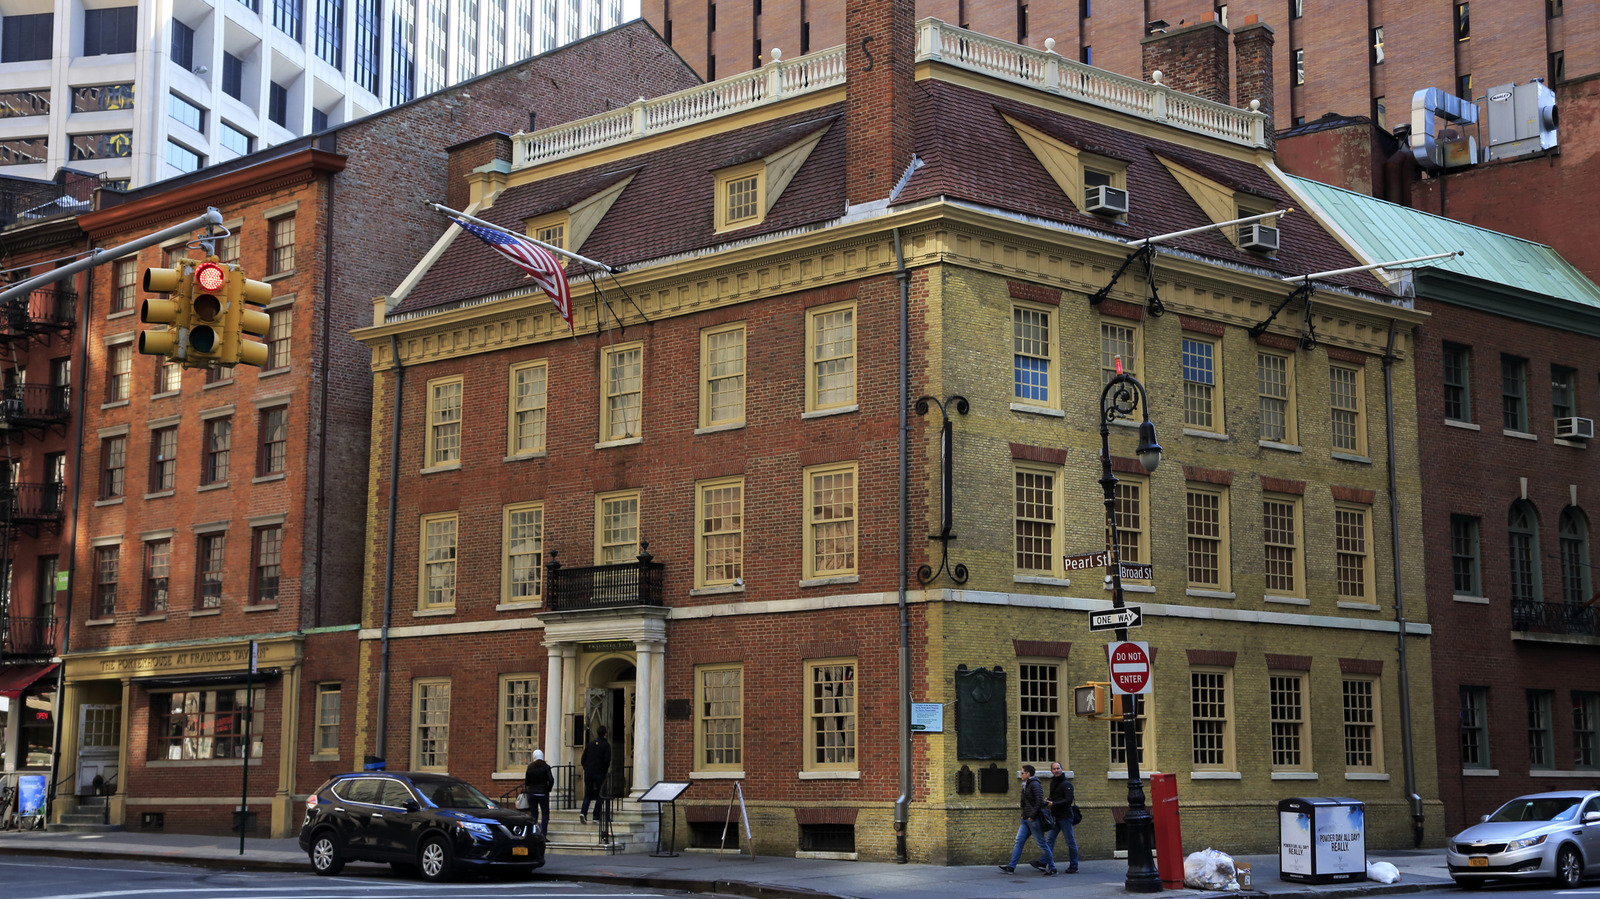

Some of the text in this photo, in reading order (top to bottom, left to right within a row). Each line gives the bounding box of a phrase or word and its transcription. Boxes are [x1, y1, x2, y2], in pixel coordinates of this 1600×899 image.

[1065, 555, 1094, 571] Pearl
[1096, 554, 1107, 567] St
[1121, 566, 1153, 580] Broad St
[1096, 613, 1134, 625] ONE WAY
[100, 659, 116, 671] THE
[118, 655, 173, 670] PORTERHOUSE
[177, 653, 188, 665] AT
[190, 650, 231, 664] FRAUNCES
[233, 647, 267, 661] TAVN
[1116, 652, 1141, 661] DO NOT
[1120, 674, 1142, 684] ENTER
[36, 712, 48, 720] OPEN
[1319, 834, 1335, 842] POWDER
[1351, 833, 1360, 841] DAY?
[1331, 842, 1349, 852] REALLY.
